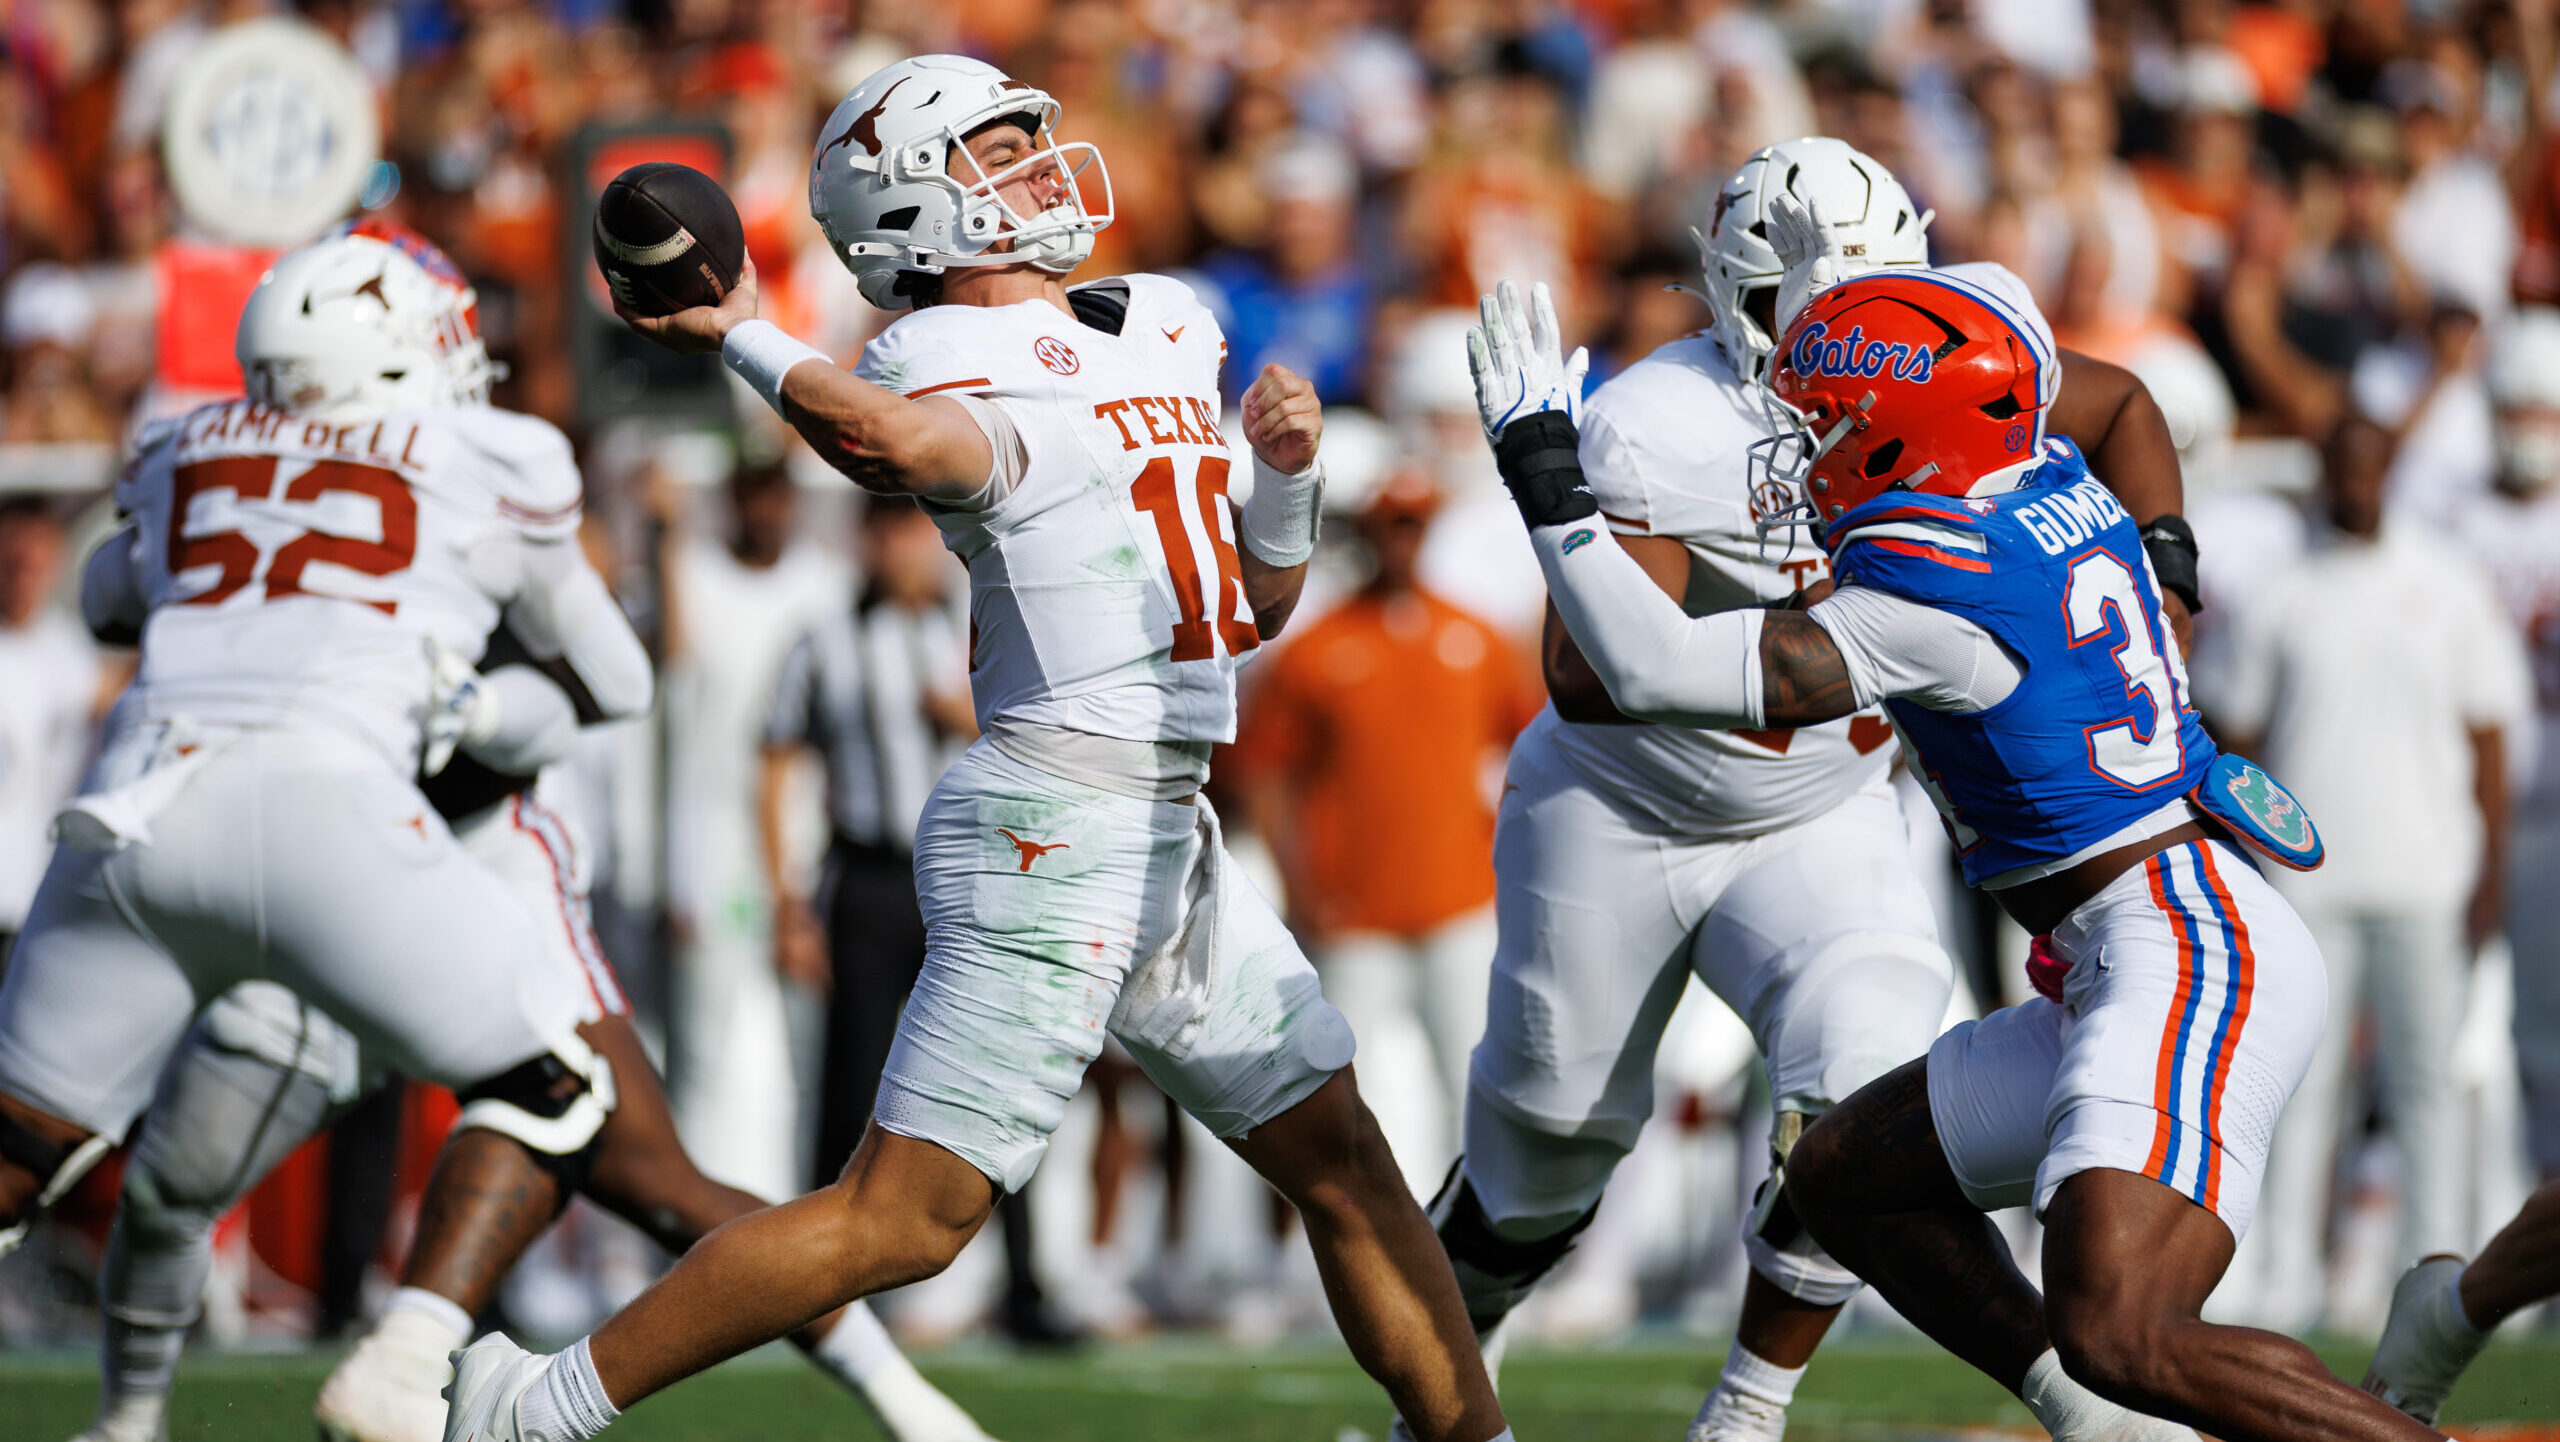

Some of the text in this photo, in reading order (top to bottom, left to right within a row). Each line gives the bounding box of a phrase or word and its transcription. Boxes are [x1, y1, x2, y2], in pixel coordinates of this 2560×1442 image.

[1034, 336, 1080, 376] SEC
[1791, 321, 1933, 385] Gators
[167, 454, 418, 618] 52
[1130, 455, 1261, 662] 16
